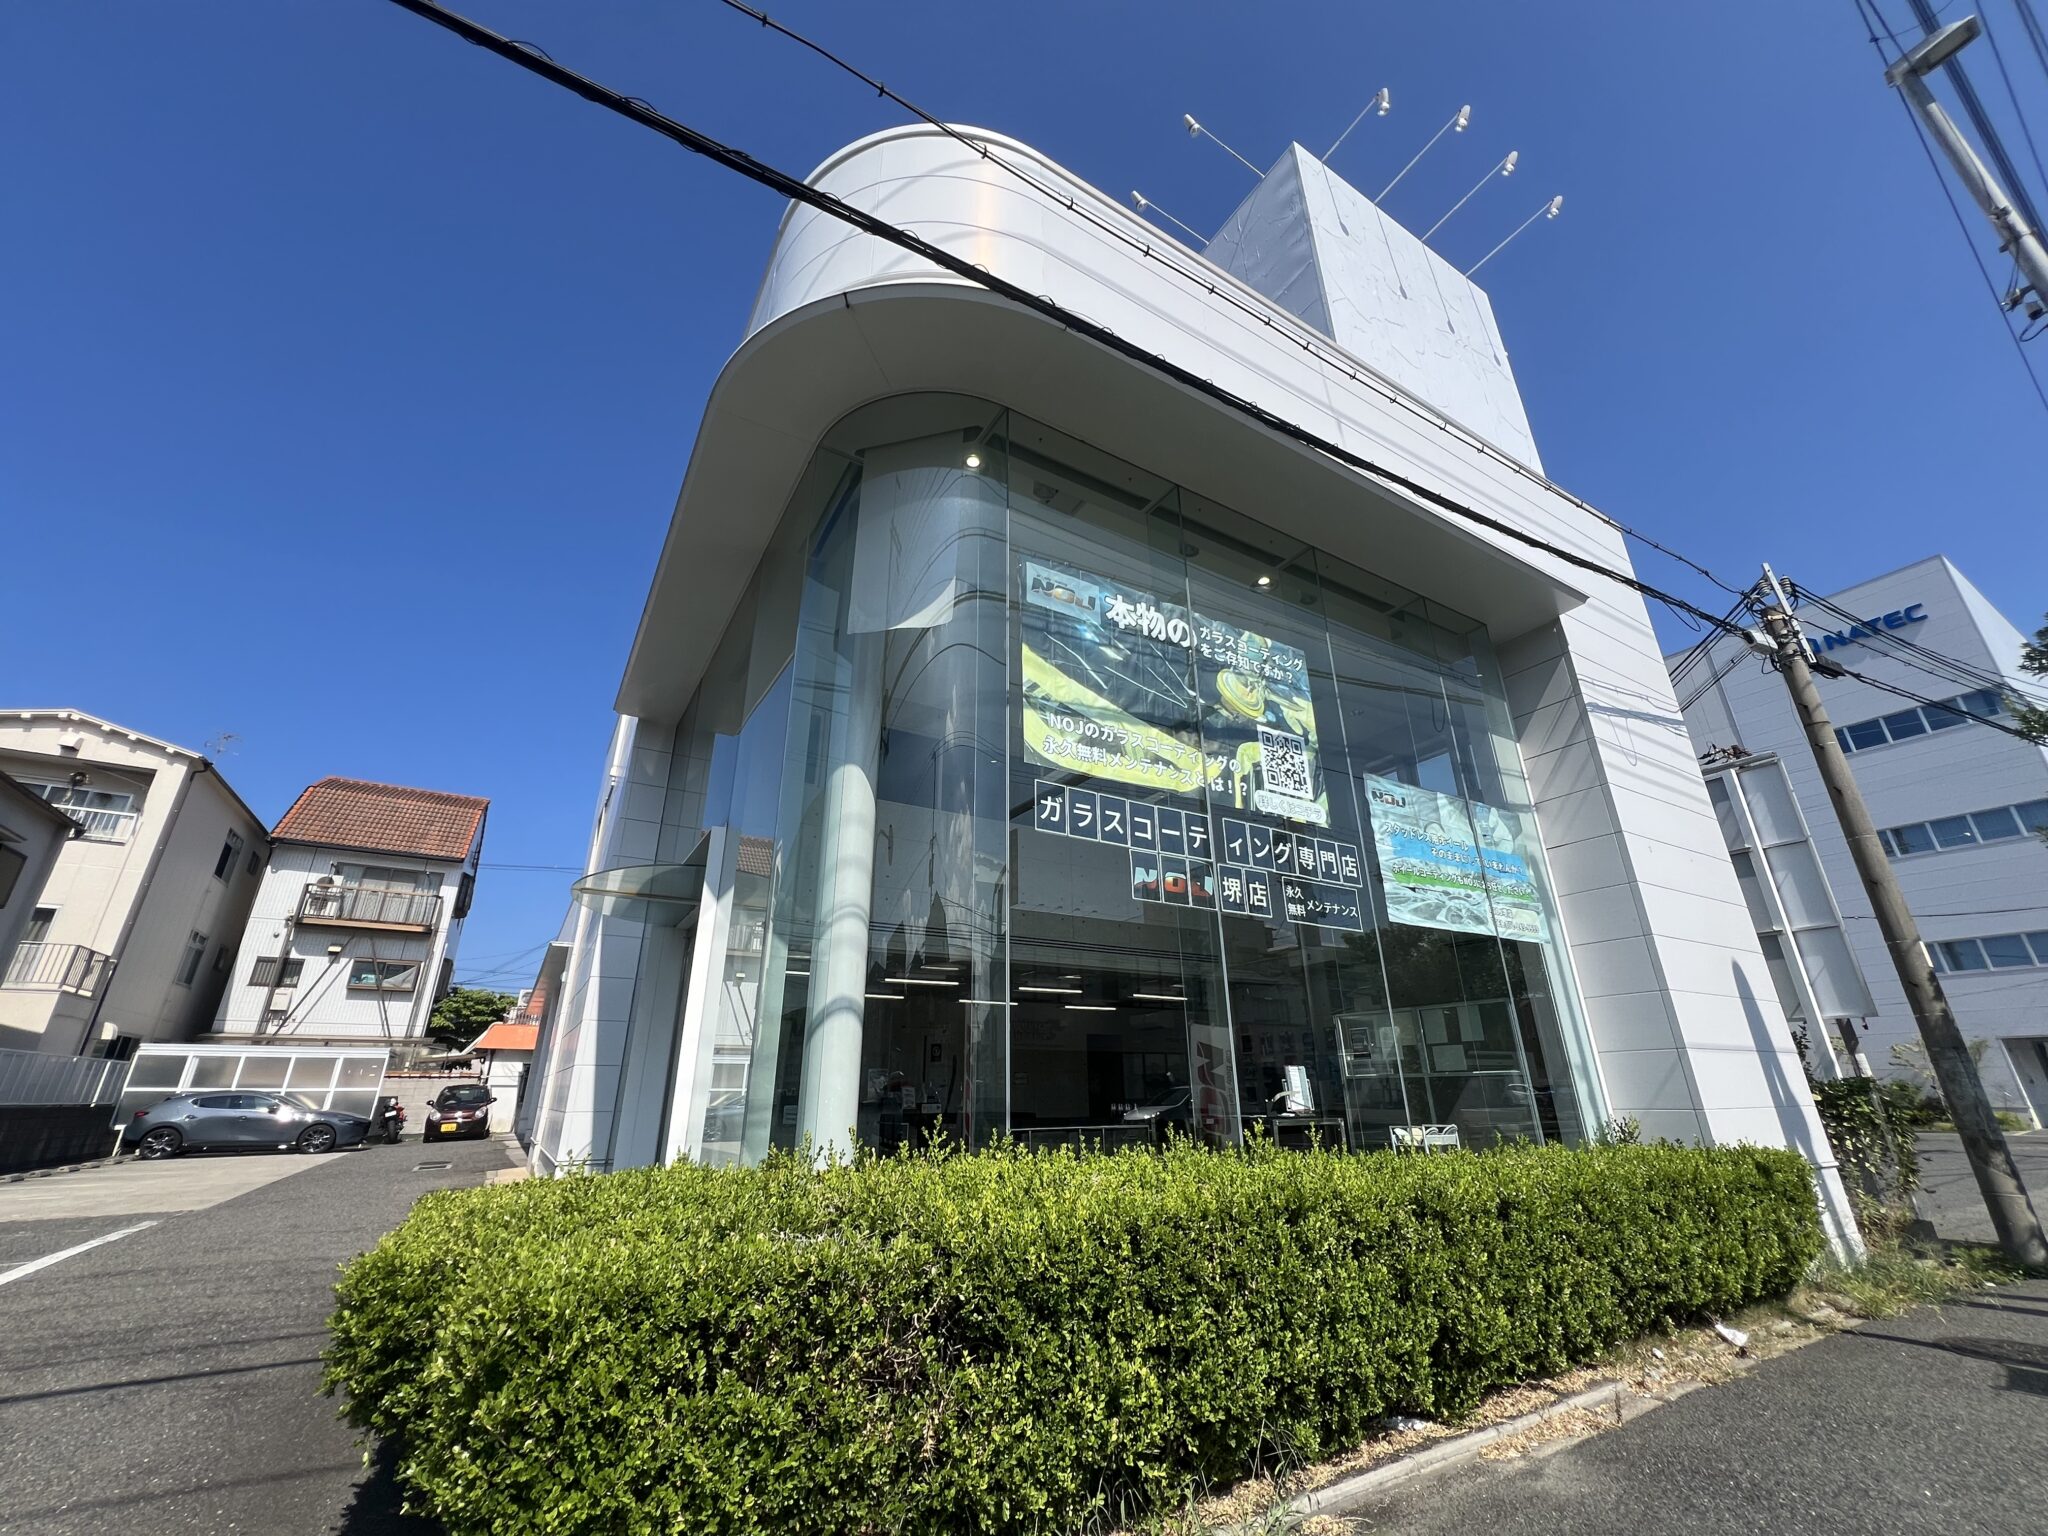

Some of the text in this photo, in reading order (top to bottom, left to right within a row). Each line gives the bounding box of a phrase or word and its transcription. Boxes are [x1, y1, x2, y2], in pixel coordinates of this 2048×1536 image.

[1104, 594, 1197, 648] 本物の
[1199, 626, 1302, 671] ガラスコーティング
[1049, 712, 1241, 773] NOJのガラスコーティングの
[1040, 795, 1358, 879] ガラスコーティング専門店
[1222, 876, 1267, 908] 堺店
[1285, 885, 1304, 900] 永久
[1287, 902, 1306, 918] 無料
[1307, 899, 1358, 918] メンテナンス
